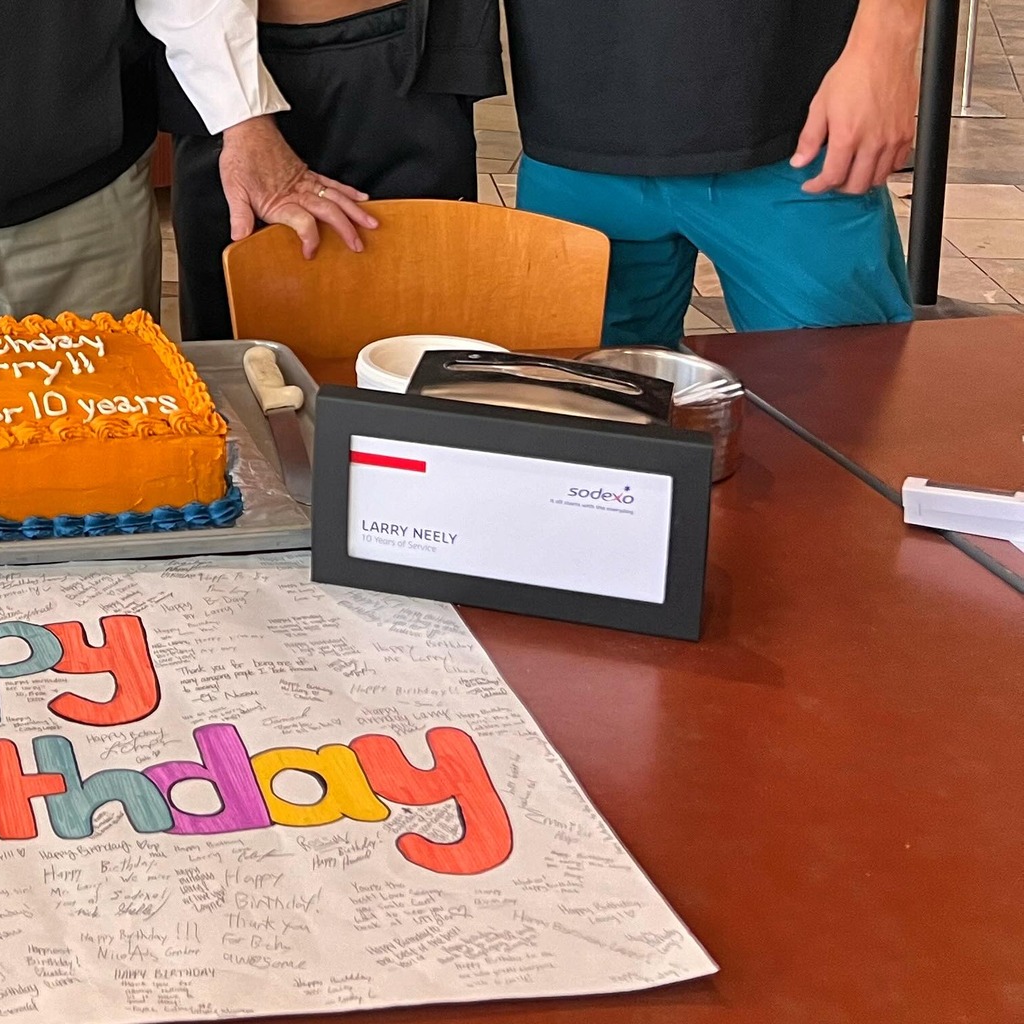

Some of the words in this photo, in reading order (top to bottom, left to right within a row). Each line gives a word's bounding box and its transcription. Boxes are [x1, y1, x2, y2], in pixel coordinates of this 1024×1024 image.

[28, 390, 67, 421] 10
[77, 393, 179, 425] years
[568, 486, 634, 504] sodexo
[362, 520, 408, 537] LARRY
[413, 527, 457, 545] NEELY
[362, 534, 372, 542] 10
[374, 536, 395, 547] Years
[397, 540, 406, 548] of
[408, 541, 437, 553] Service
[226, 866, 284, 888] Happy
